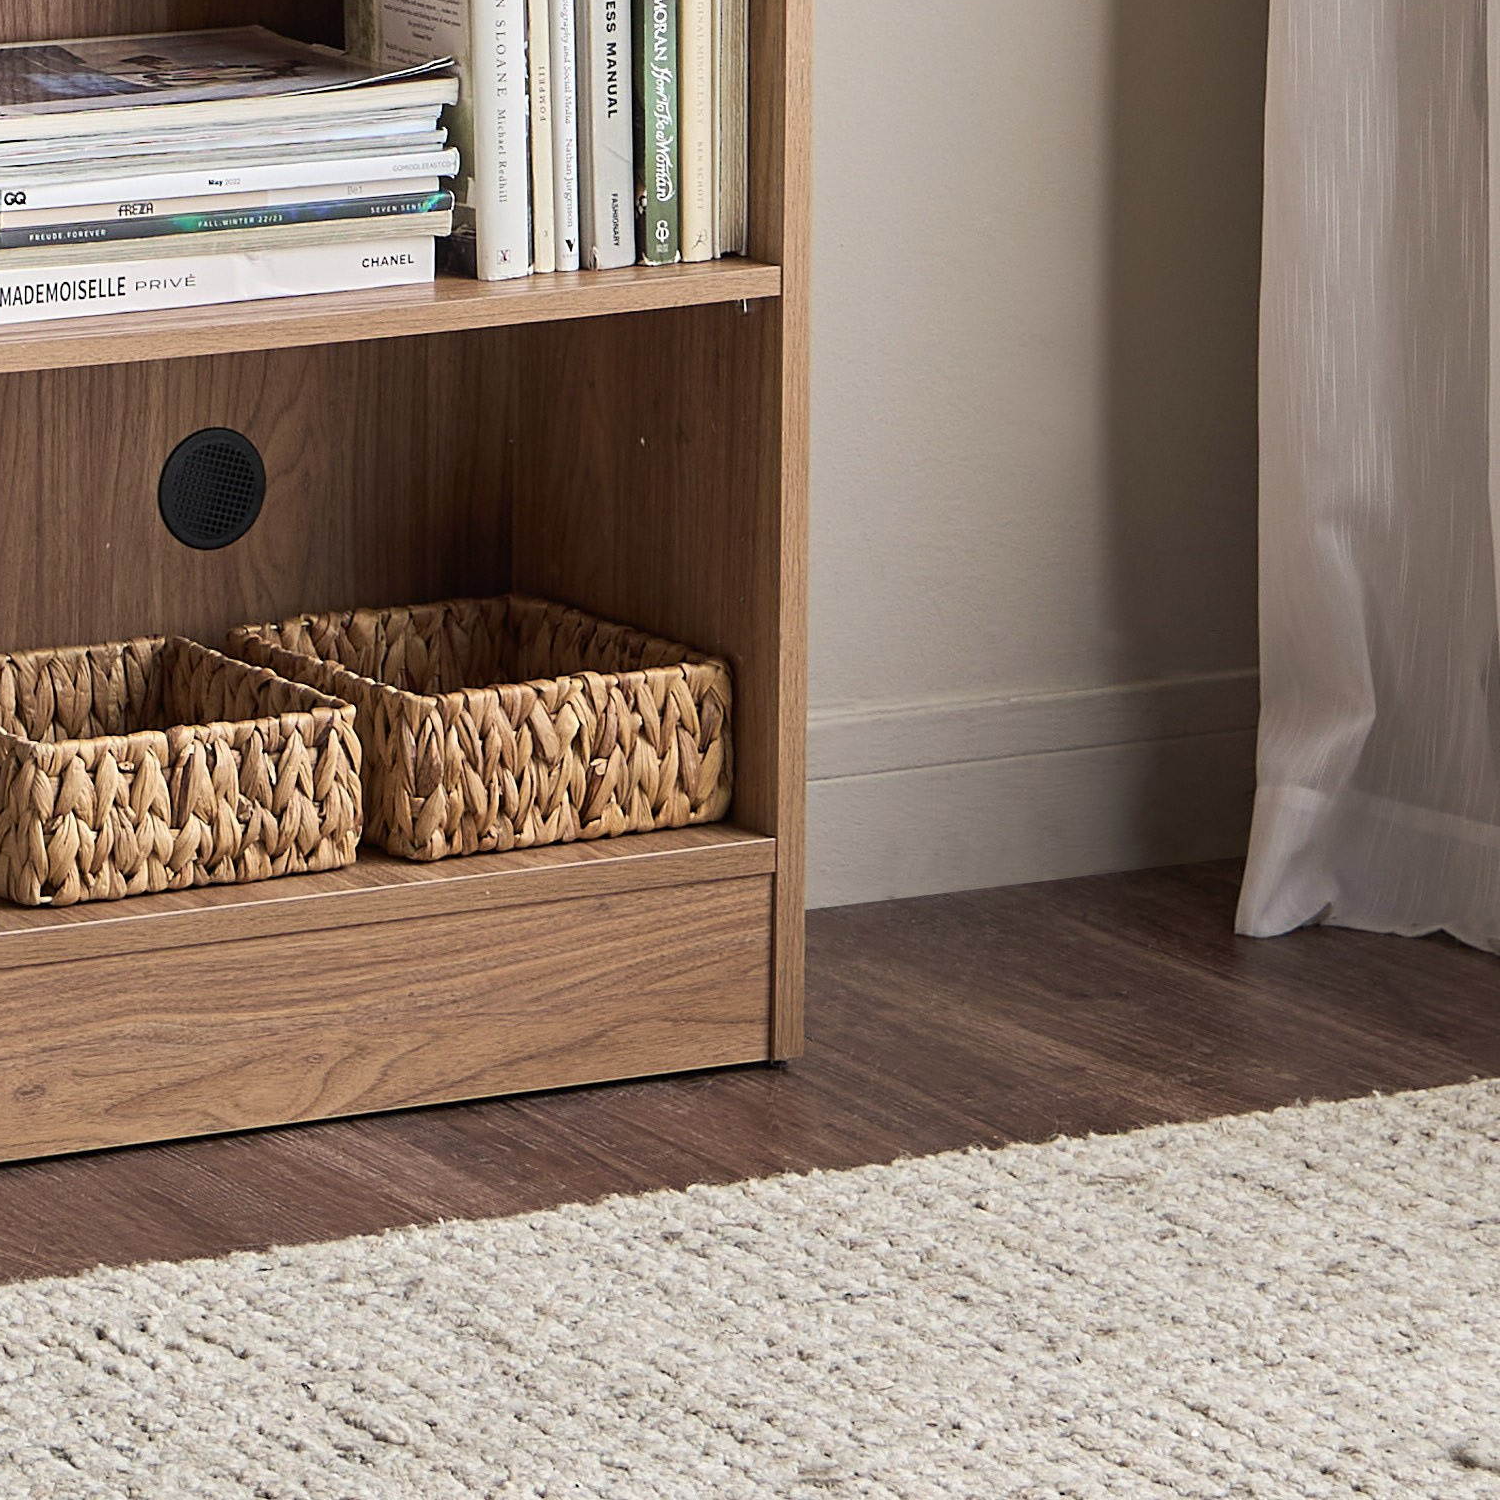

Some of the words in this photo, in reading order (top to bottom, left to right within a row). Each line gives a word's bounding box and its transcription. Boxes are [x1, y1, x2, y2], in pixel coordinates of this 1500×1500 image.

[495, 19, 507, 98] SLOANE
[564, 66, 573, 94] Social
[606, 41, 619, 119] MANUAL
[538, 66, 547, 122] POMPEII
[497, 108, 507, 154] Michael
[565, 138, 575, 175] Nathan
[655, 135, 676, 202] Woman
[4, 191, 27, 206] GQ
[208, 178, 223, 188] May
[498, 160, 508, 204] Redhill
[564, 177, 576, 228] Jurgenson
[370, 204, 398, 214] SEVEN
[610, 193, 621, 247] FASHIONARY
[135, 273, 197, 292] PRIVÉ
[361, 254, 415, 270] CHANEL
